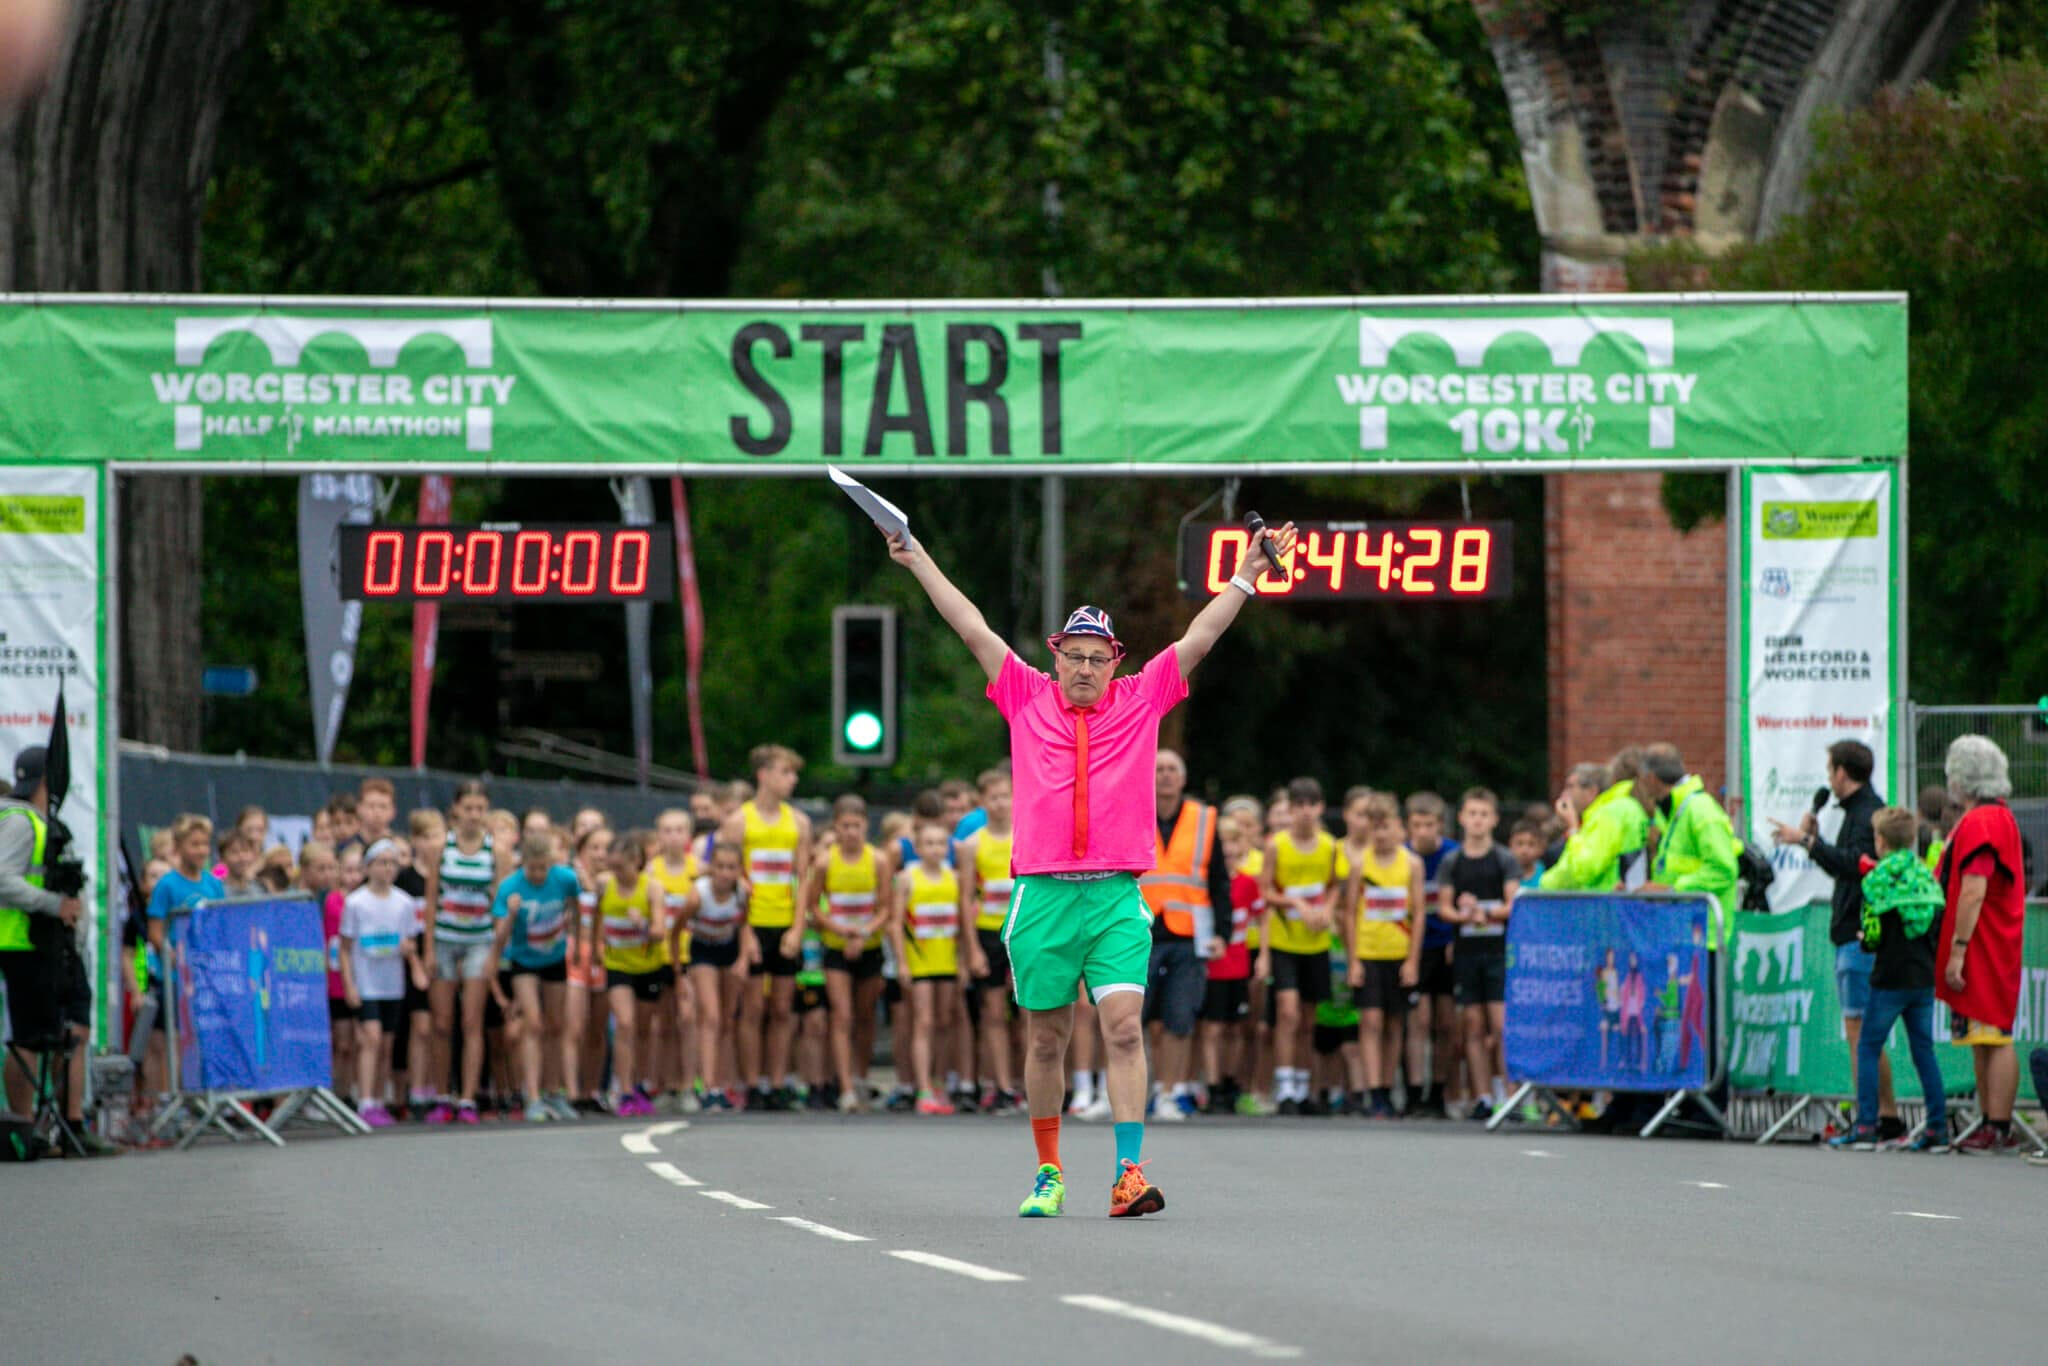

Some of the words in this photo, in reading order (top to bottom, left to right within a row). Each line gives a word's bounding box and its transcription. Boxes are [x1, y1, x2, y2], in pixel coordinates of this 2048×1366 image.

[150, 373, 414, 404] WORCESTER
[424, 374, 517, 405] CITY
[729, 321, 1083, 456] START
[1336, 373, 1596, 406] WORCESTER
[1605, 373, 1698, 405] CITY
[205, 415, 273, 435] HALF
[313, 415, 462, 436] MARATHON
[1448, 407, 1570, 453] 10K
[363, 530, 651, 595] 00:00:00
[1764, 667, 1871, 680] WORCESTER
[1832, 715, 1869, 729] News
